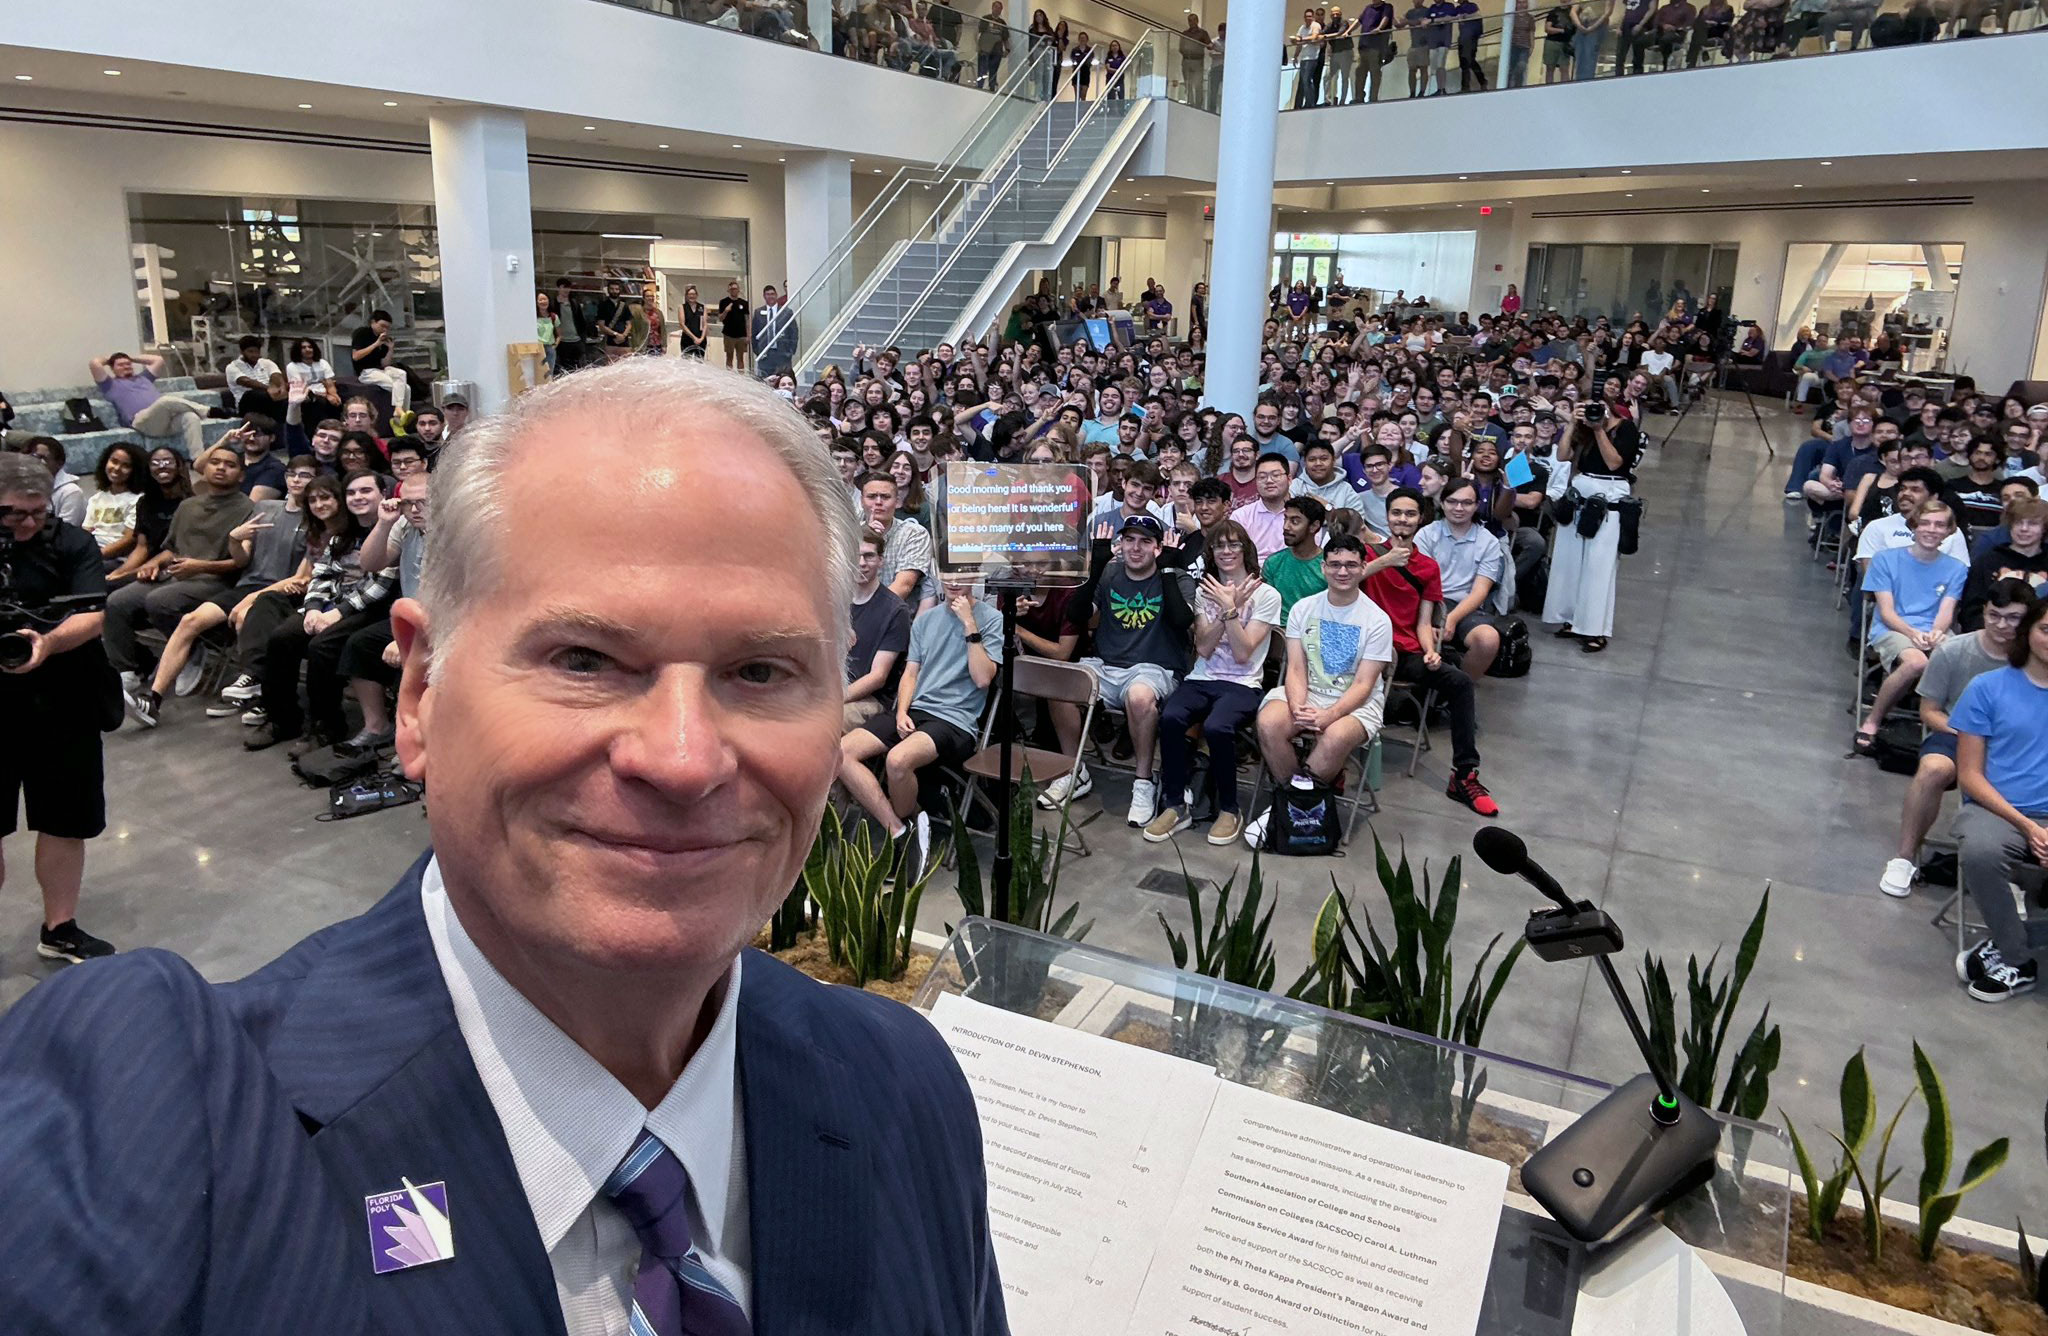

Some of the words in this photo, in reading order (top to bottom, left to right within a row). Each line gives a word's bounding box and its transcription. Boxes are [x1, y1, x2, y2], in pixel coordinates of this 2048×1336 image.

[948, 484, 970, 493] Good
[972, 484, 1009, 495] morning
[1011, 484, 1027, 492] and
[1029, 484, 1054, 492] thank
[1056, 485, 1072, 494] you
[962, 504, 986, 514] being
[1020, 503, 1028, 512] is
[1029, 503, 1073, 512] wonderful
[989, 524, 1013, 534] many
[1015, 522, 1025, 532] of
[1026, 524, 1043, 534] you
[1044, 522, 1064, 532] here
[951, 1026, 1004, 1046] INTRODUCTION
[1014, 1044, 1026, 1054] DR.
[1028, 1049, 1051, 1061] DEVIN
[1051, 1056, 1101, 1077] STEPHENSON,
[995, 1099, 1026, 1115] President,
[1037, 1113, 1056, 1124] Devin
[1057, 1119, 1098, 1138] Stephenson,
[1058, 1101, 1078, 1111] honor
[997, 1120, 1012, 1128] your
[1002, 1145, 1027, 1157] second
[1026, 1153, 1058, 1168] president
[1067, 1166, 1090, 1179] Florida
[1237, 1135, 1264, 1148] achieve
[1265, 1144, 1317, 1164] organizational
[1399, 1185, 1447, 1205] Stephenson
[1243, 1118, 1298, 1138] comprehensive
[1298, 1135, 1351, 1155] administrative
[1352, 1152, 1367, 1160] and
[1368, 1157, 1412, 1174] operational
[1413, 1170, 1455, 1188] leadership
[995, 1162, 1005, 1170] his
[1005, 1167, 1042, 1184] presidency
[1049, 1182, 1064, 1191] July
[1064, 1186, 1082, 1198] 2024,
[1230, 1152, 1244, 1161] has
[1245, 1158, 1271, 1169] earned
[1271, 1166, 1309, 1181] numerous
[1342, 1188, 1377, 1206] including
[1379, 1200, 1391, 1209] the
[1393, 1205, 1437, 1222] prestigious
[370, 1193, 403, 1206] FLORIDA
[370, 1204, 390, 1214] POLY
[1224, 1170, 1259, 1186] Southern
[1260, 1182, 1306, 1201] Association
[1317, 1200, 1348, 1215] College
[1349, 1212, 1365, 1221] and
[1366, 1216, 1400, 1232] Schools
[1021, 1218, 1061, 1236] responsible
[1217, 1188, 1266, 1209] Commission
[1279, 1208, 1313, 1224] Colleges
[1315, 1220, 1362, 1242] (SACSCOC)
[1364, 1236, 1387, 1249] Carol
[1399, 1248, 1437, 1266] Luthman
[1024, 1241, 1038, 1250] and
[1210, 1206, 1255, 1226] Meritorious
[1256, 1222, 1286, 1237] Service
[1287, 1233, 1314, 1246] Award
[1315, 1241, 1326, 1250] for
[1327, 1246, 1339, 1255] his
[1340, 1250, 1368, 1265] faithful
[1370, 1262, 1386, 1270] and
[1386, 1267, 1428, 1285] dedicated
[1203, 1226, 1230, 1239] service
[1231, 1235, 1247, 1244] and
[1247, 1241, 1277, 1256] support
[1288, 1254, 1301, 1264] the
[1302, 1259, 1343, 1278] SACSCOC
[1356, 1279, 1373, 1288] well
[1385, 1289, 1423, 1307] receiving
[1015, 1286, 1028, 1296] has
[1182, 1285, 1212, 1300] support
[1221, 1300, 1252, 1315] student
[1189, 1264, 1202, 1273] the
[1204, 1269, 1232, 1285] Shirley
[1233, 1279, 1240, 1287] B.
[1243, 1283, 1273, 1299] Gordon
[1274, 1295, 1301, 1309] Award
[1313, 1308, 1360, 1330] Distinction
[1361, 1325, 1374, 1334] for
[1196, 1244, 1214, 1254] both
[1215, 1251, 1228, 1260] the
[1230, 1255, 1243, 1265] Phi
[1245, 1260, 1266, 1274] Theta
[1268, 1269, 1294, 1284] Kappa
[1296, 1279, 1342, 1300] President's
[1344, 1296, 1379, 1313] Paragon
[1380, 1309, 1409, 1324] Award
[1410, 1321, 1427, 1330] and
